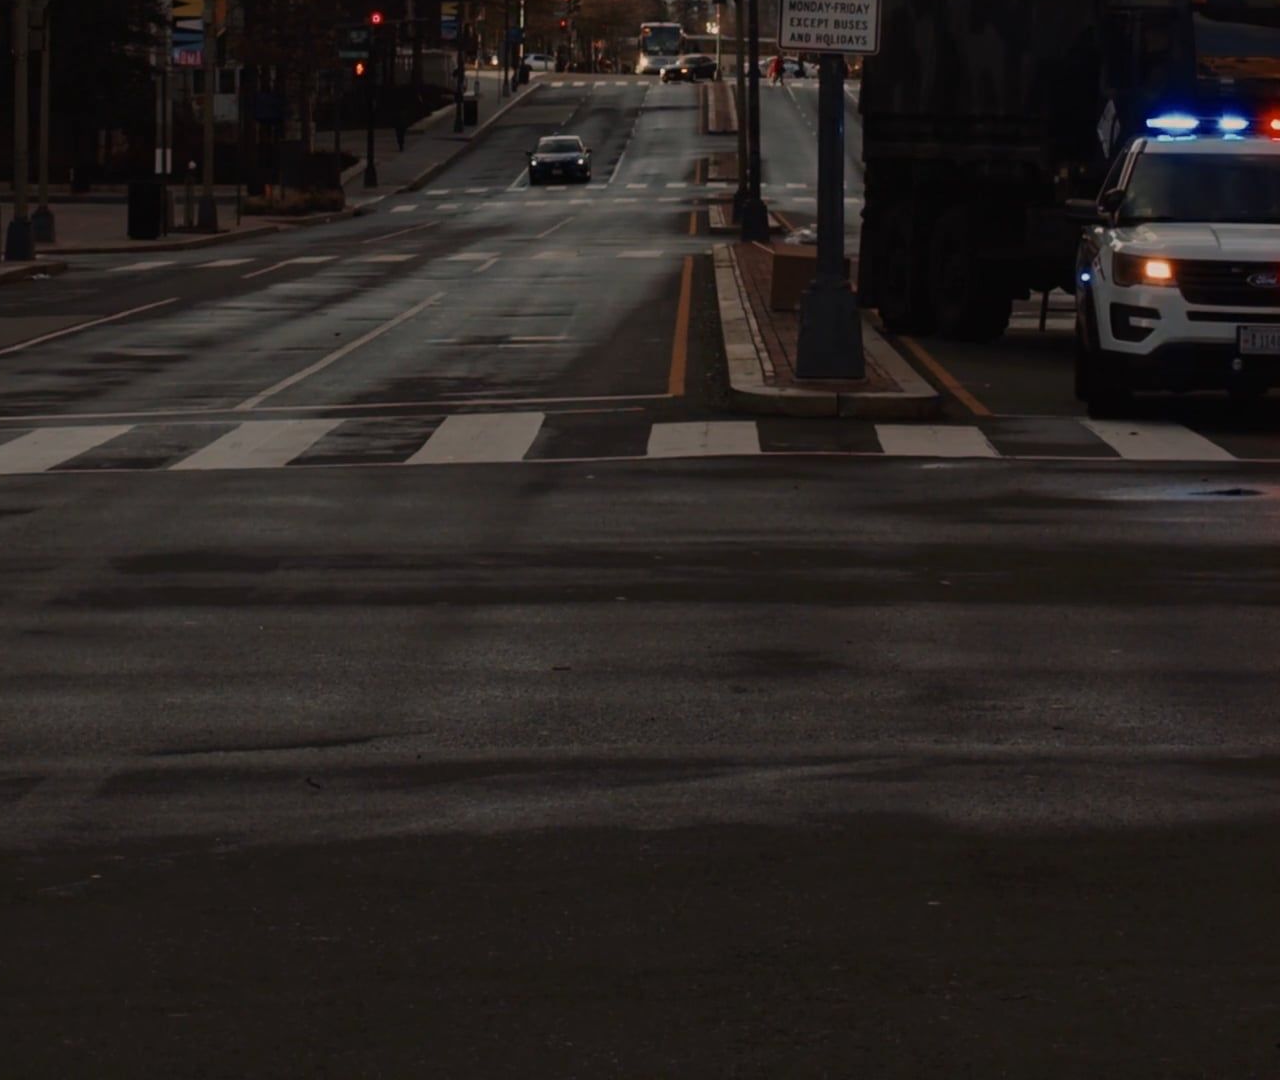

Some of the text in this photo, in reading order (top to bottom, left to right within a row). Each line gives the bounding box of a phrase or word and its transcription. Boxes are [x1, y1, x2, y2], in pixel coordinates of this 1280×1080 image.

[789, 1, 869, 14] MONDAY-FRIDAY
[790, 17, 868, 31] EXCEPT BUSES
[790, 33, 867, 46] AND HOLIDAYS
